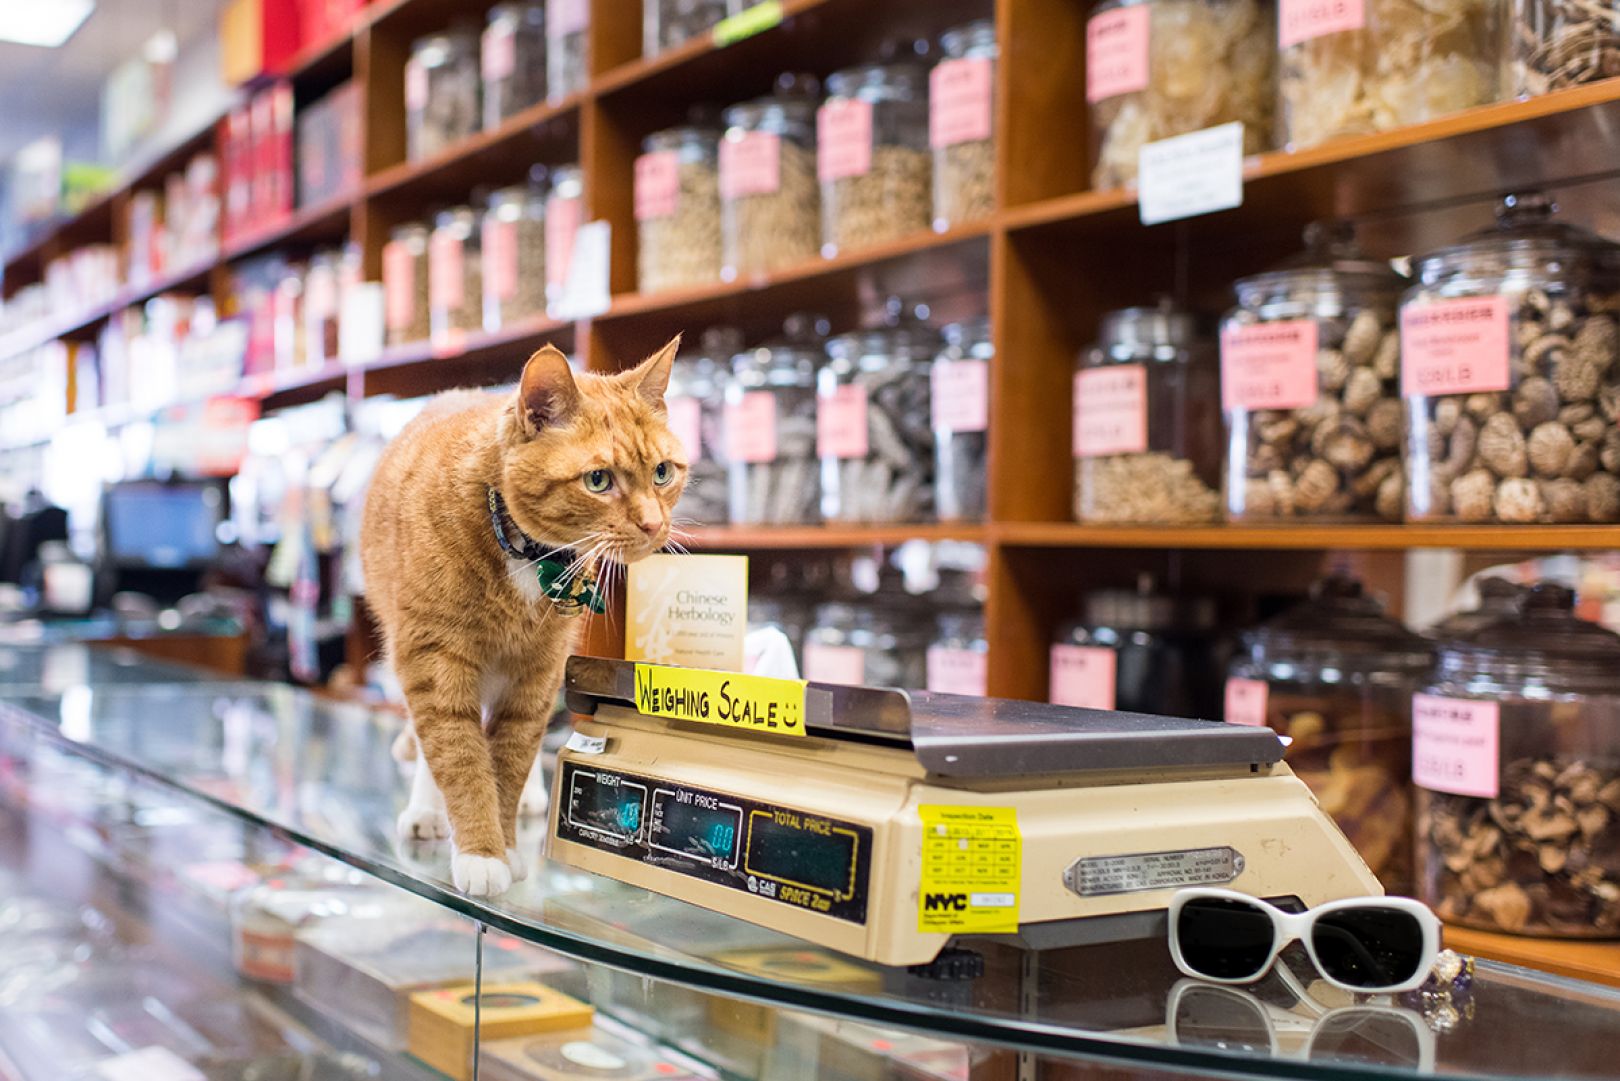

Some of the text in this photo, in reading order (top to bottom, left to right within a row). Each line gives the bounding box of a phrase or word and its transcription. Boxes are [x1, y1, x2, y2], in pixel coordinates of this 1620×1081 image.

[675, 590, 728, 606] Chinese
[667, 606, 736, 626] Herbology
[637, 668, 778, 728] WEIGHING SCALE
[596, 773, 621, 788] WEIGHT
[676, 789, 718, 810] UNIT PRICE
[774, 811, 832, 836] TOTAL PRICE
[925, 892, 968, 912] NYC
